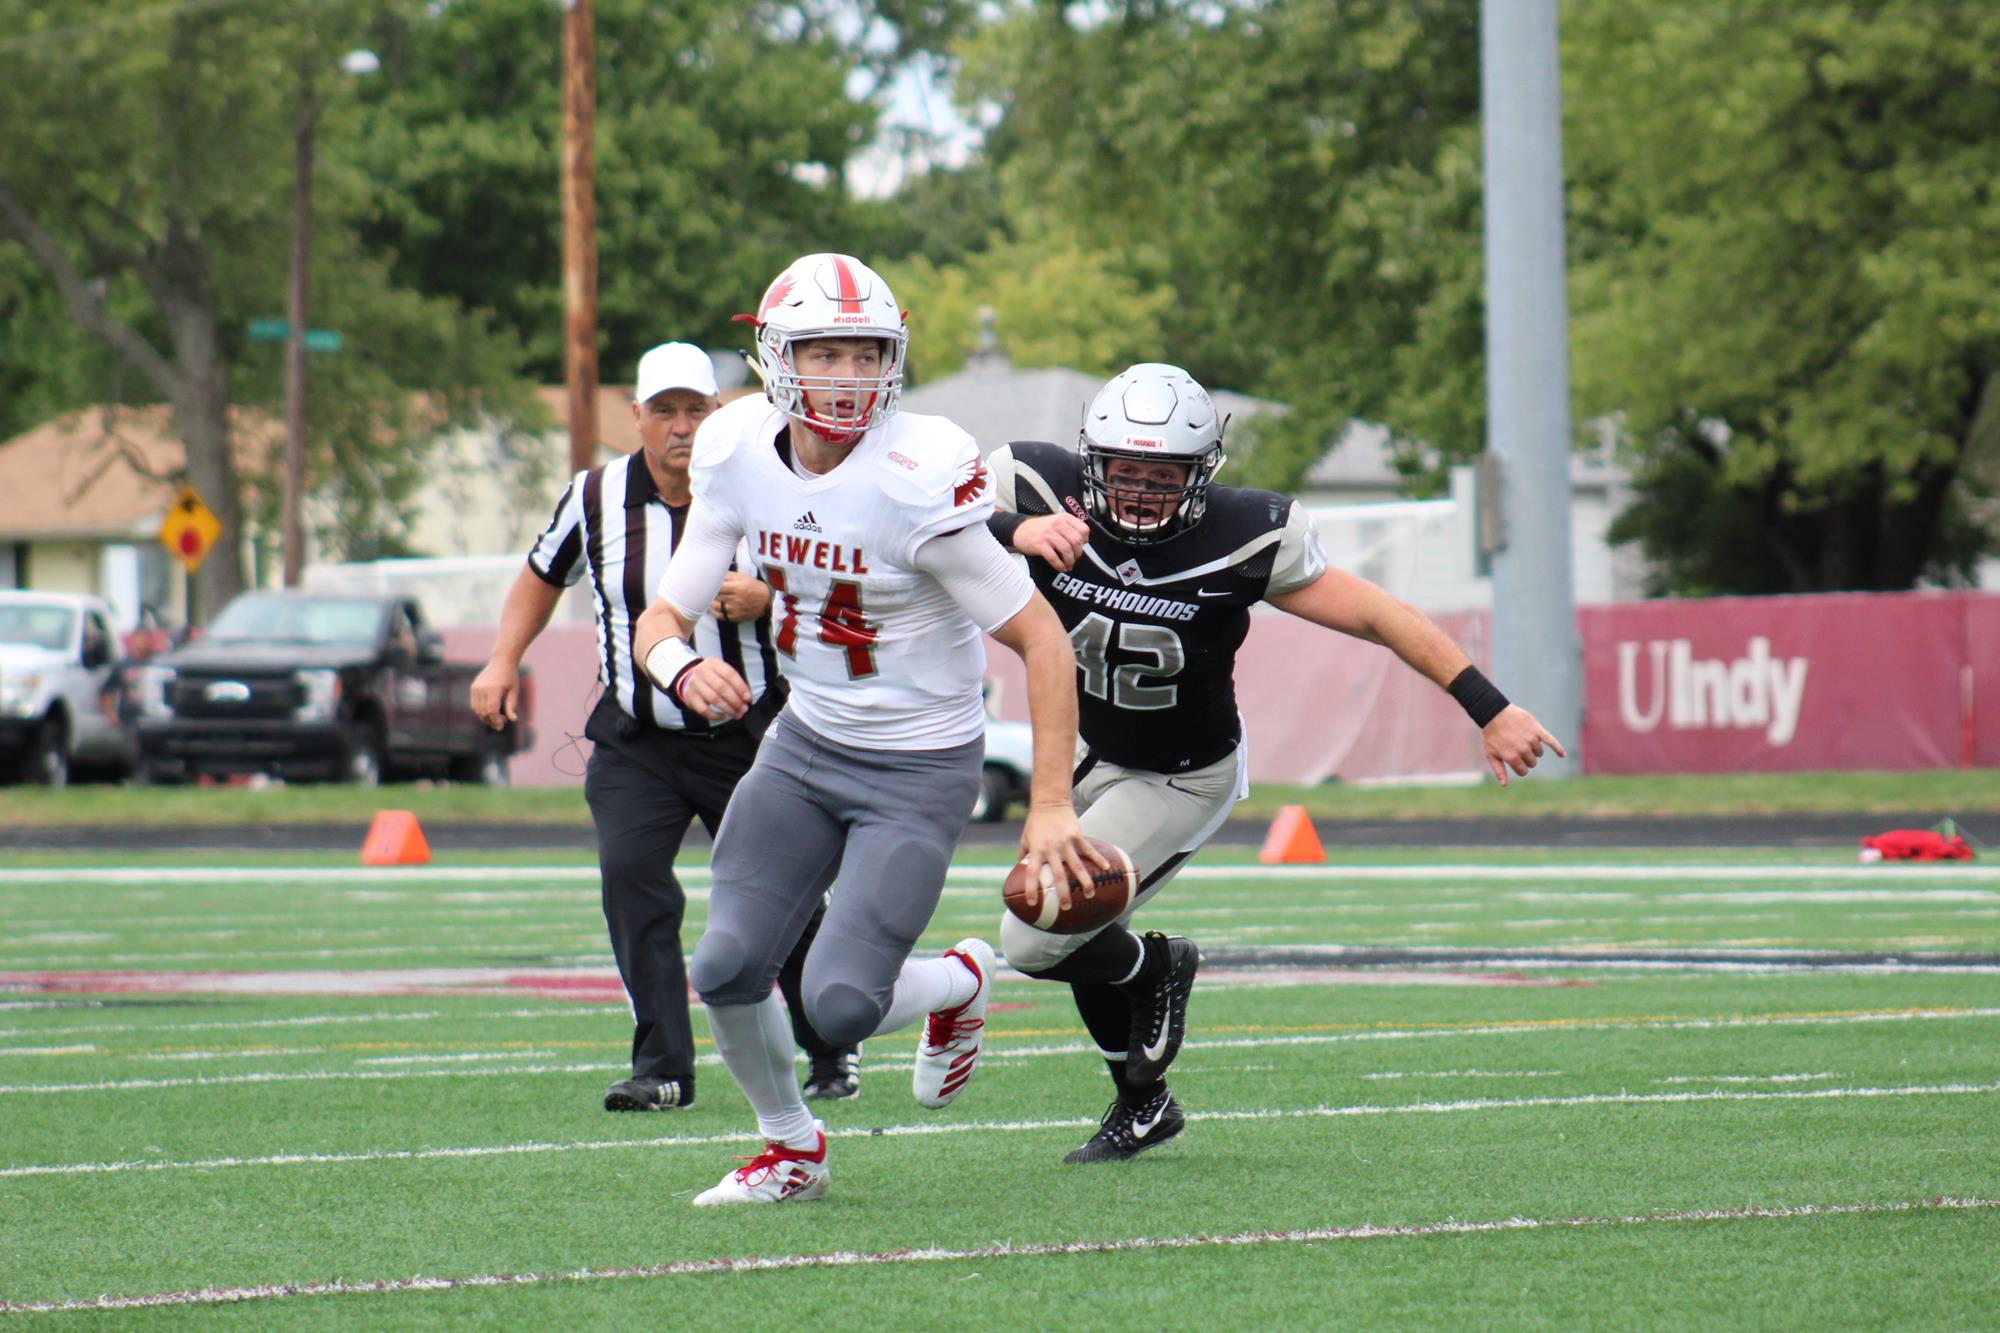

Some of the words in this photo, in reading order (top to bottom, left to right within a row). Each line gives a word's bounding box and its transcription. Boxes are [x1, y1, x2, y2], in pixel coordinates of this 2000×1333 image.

[834, 315, 870, 324] Riddell
[758, 530, 869, 574] JEWELL
[793, 522, 822, 534] adidas
[1051, 572, 1200, 621] GREYHOUNDS
[762, 562, 882, 681] 14
[1068, 611, 1185, 710] 42
[1617, 635, 1809, 747] UIndy
